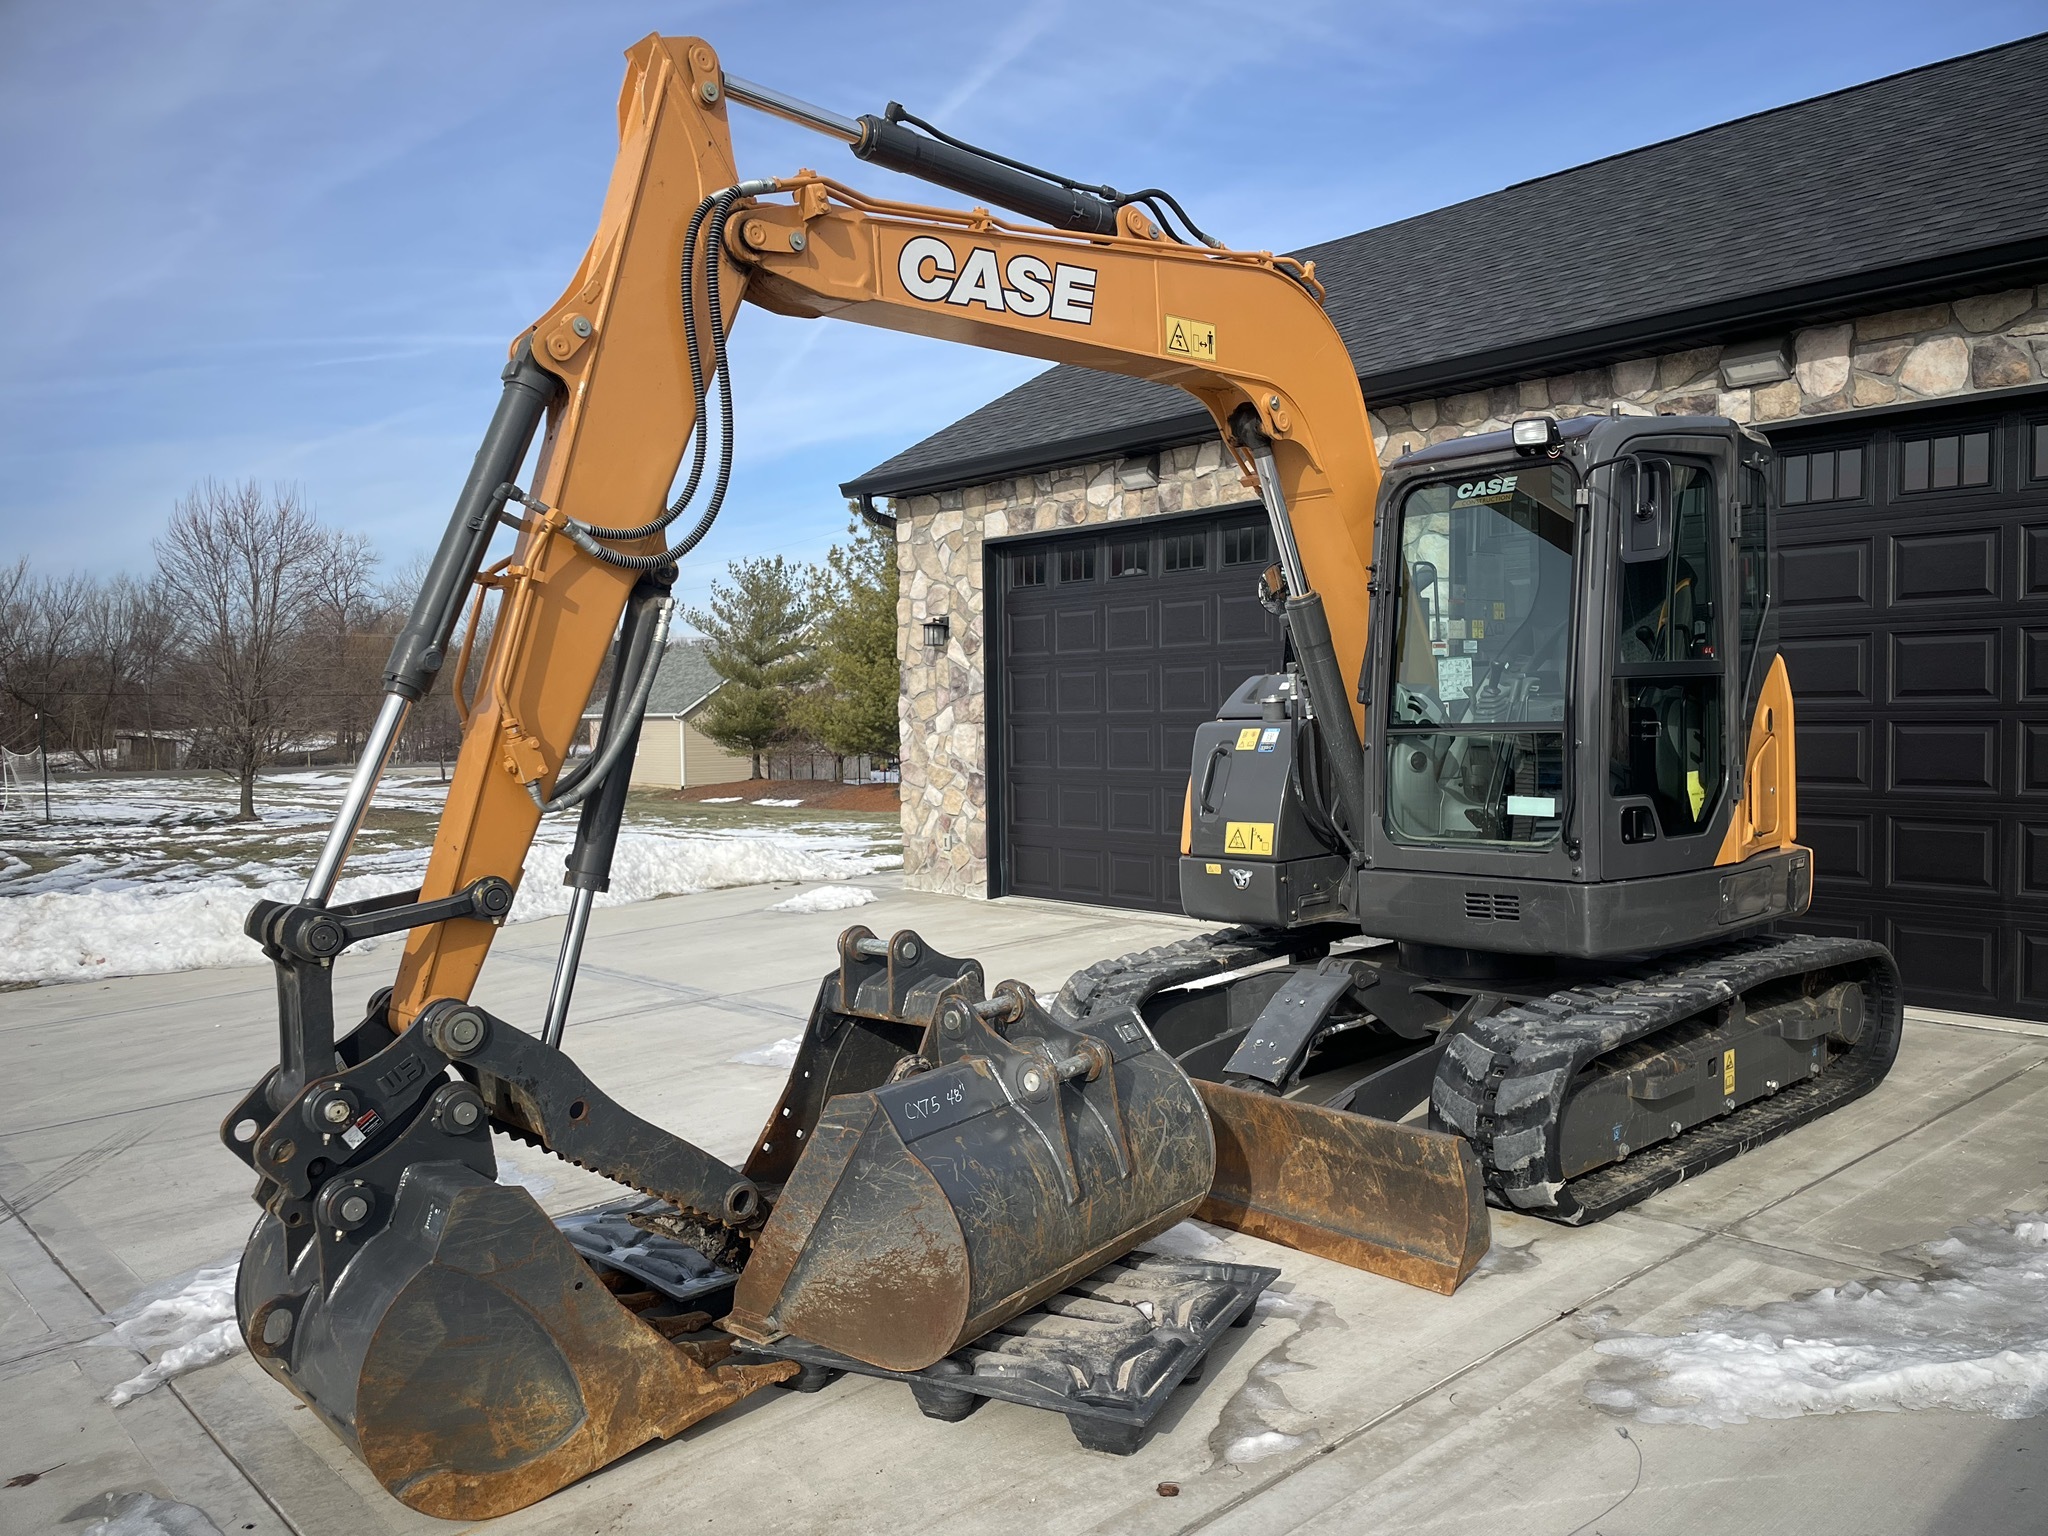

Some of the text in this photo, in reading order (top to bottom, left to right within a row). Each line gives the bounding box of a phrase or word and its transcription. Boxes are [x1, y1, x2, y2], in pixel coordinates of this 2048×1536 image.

[898, 236, 1097, 325] CASE
[1457, 475, 1518, 498] CASE
[1461, 495, 1511, 506] CONSTRUCTION
[904, 1094, 941, 1120] CX75
